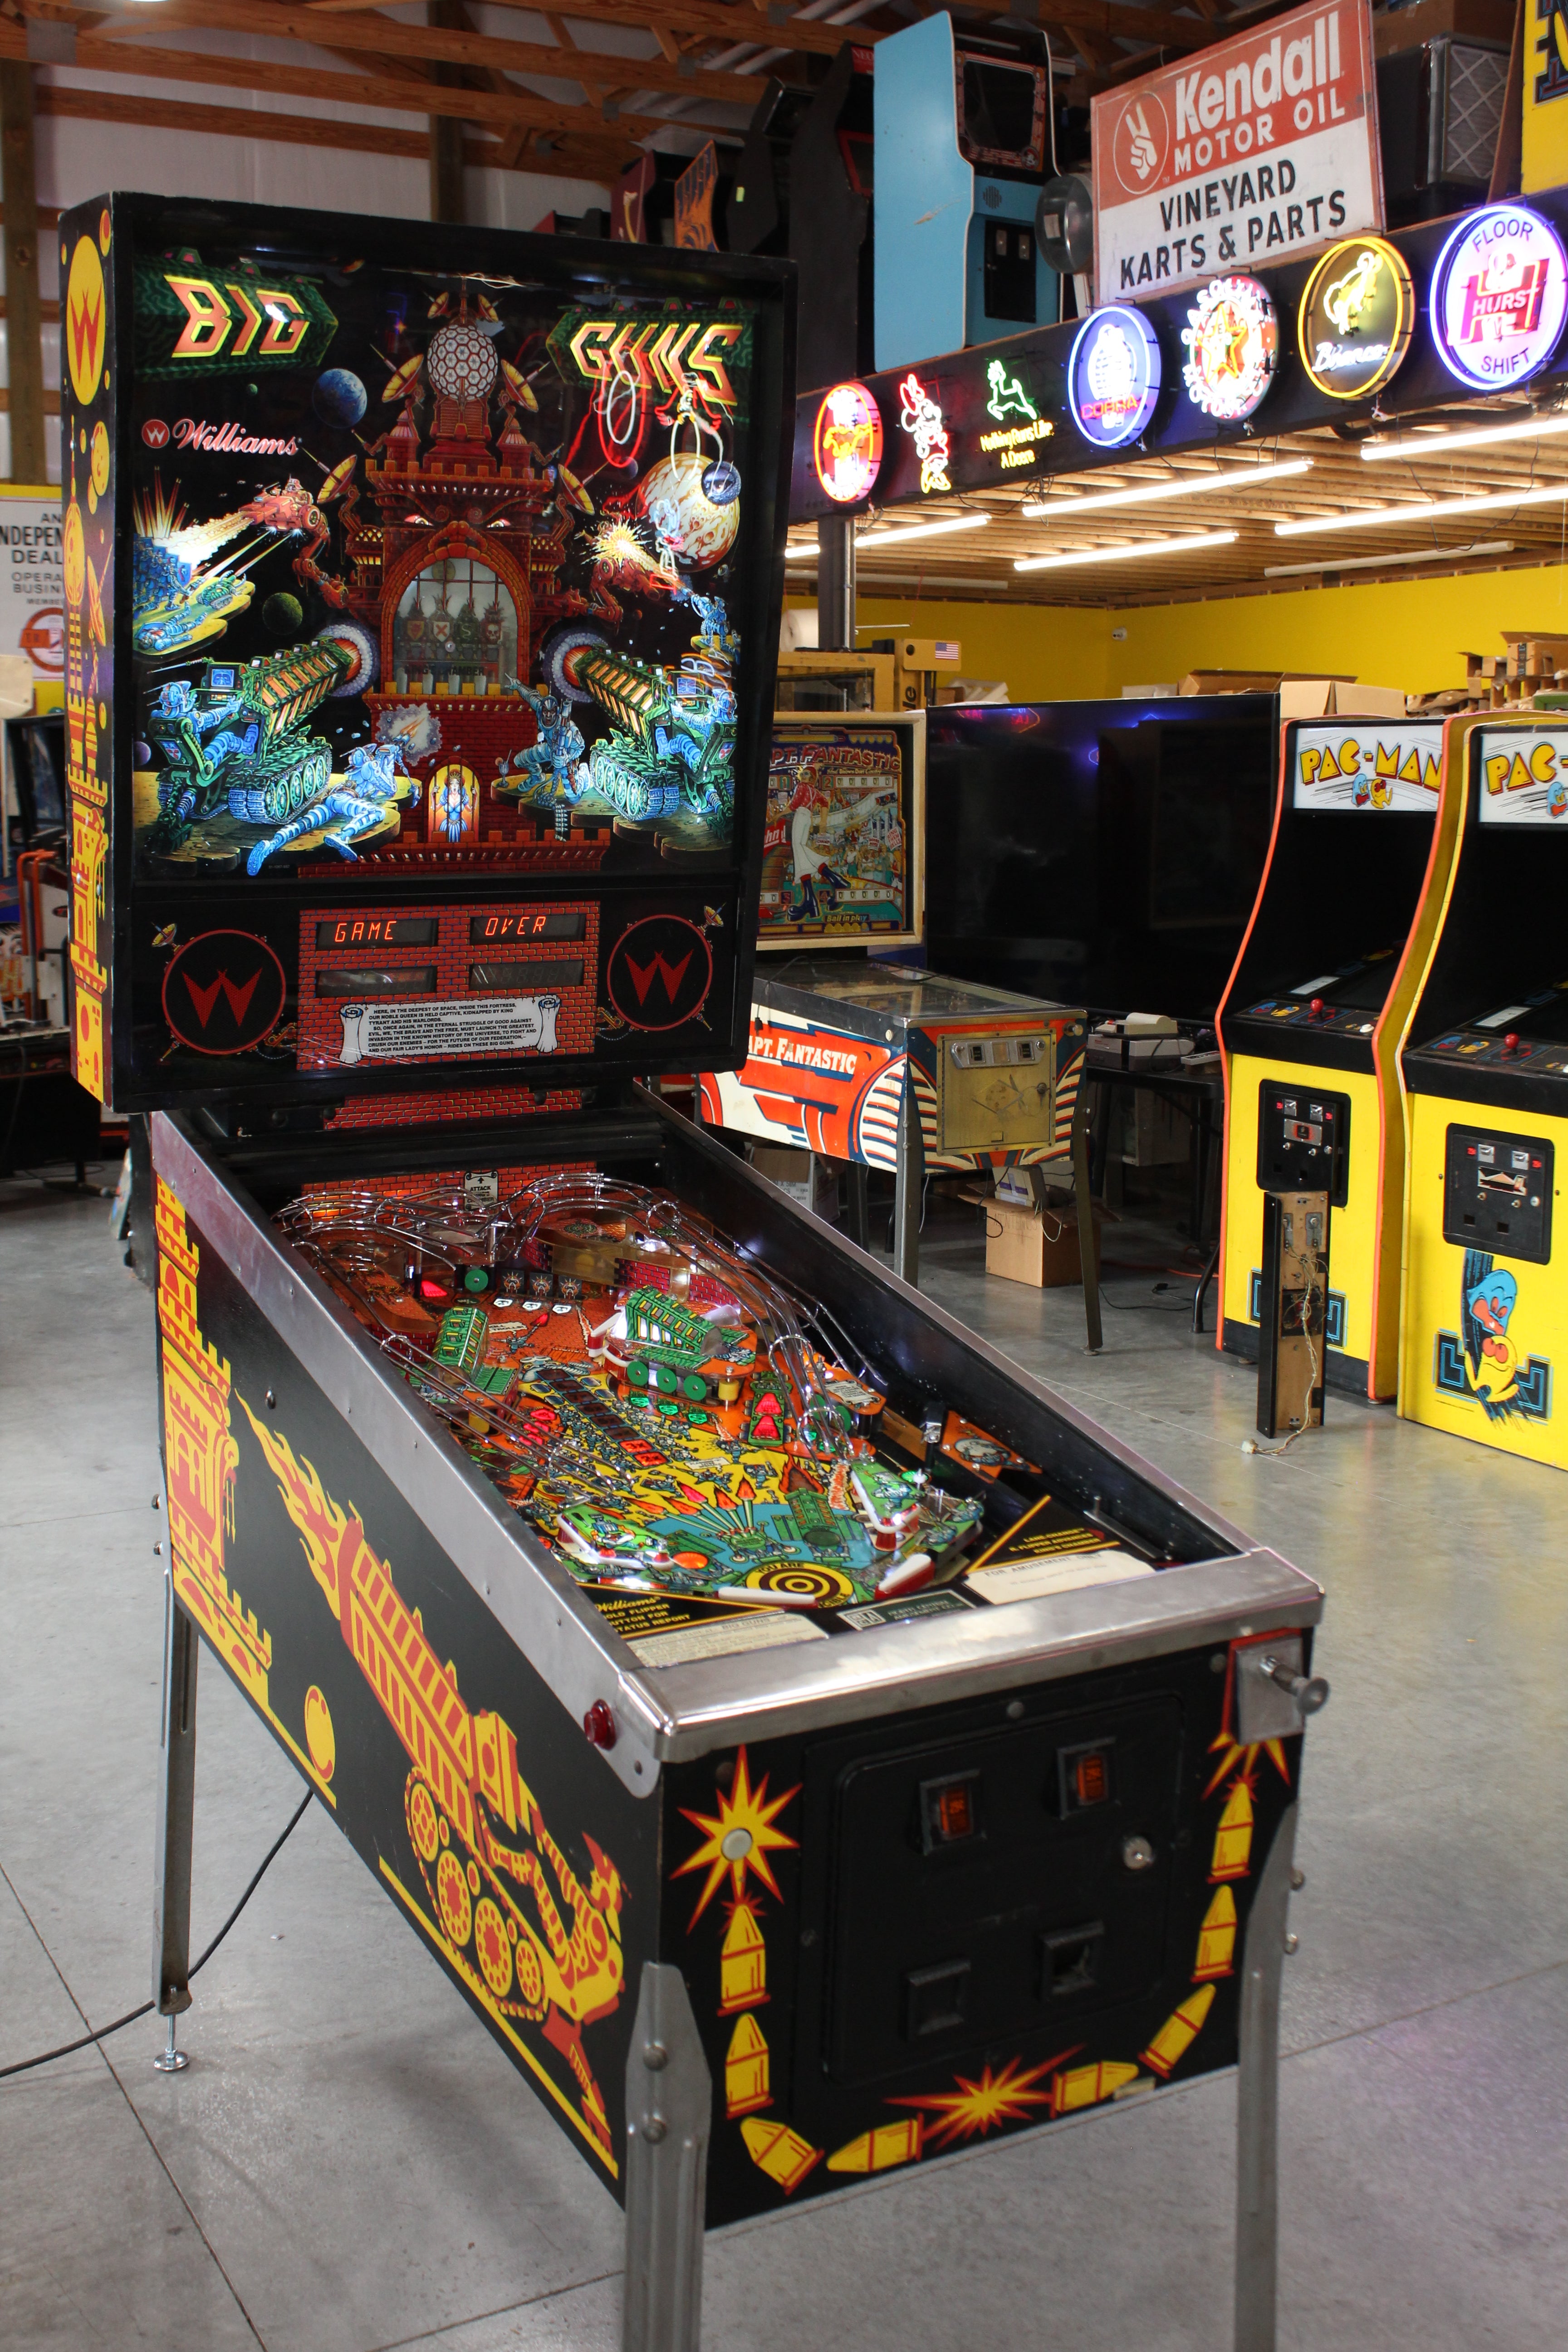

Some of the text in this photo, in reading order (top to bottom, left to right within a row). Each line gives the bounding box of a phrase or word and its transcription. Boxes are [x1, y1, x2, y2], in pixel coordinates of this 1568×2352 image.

[1177, 11, 1340, 141] Kendall
[1173, 89, 1346, 176] MOTOR OIL
[1160, 159, 1296, 232] VINEYARD
[1120, 190, 1347, 289] KARTS & PARTS
[1472, 219, 1533, 253] FLOOR
[1472, 285, 1540, 316] HURST
[164, 274, 310, 358] BIG
[569, 321, 743, 407] GUNS
[1481, 348, 1529, 374] SHIFT
[1080, 394, 1138, 420] COBRA
[172, 418, 299, 455] Williams
[980, 419, 1053, 452] Nothing Runs Like
[1001, 451, 1010, 469] A
[40, 513, 62, 523] AN
[11, 549, 63, 564] DEAL
[13, 583, 62, 594] BUSIN
[801, 744, 901, 770] FANTASTIC
[1298, 737, 1443, 794] PAC-MAN
[1483, 741, 1568, 796] PAC-
[334, 921, 397, 942] GAME
[485, 916, 547, 936] OVER
[776, 1037, 858, 1075] FANTASTIC
[755, 1564, 778, 1575] YOU
[985, 1568, 1009, 1577] FOR
[1011, 1557, 1070, 1573] AMUSEMENT
[595, 1598, 657, 1612] Williams
[604, 1603, 670, 1620] OLD FLIPPER
[647, 1611, 669, 1619] FOR
[652, 1613, 691, 1626] REPORT
